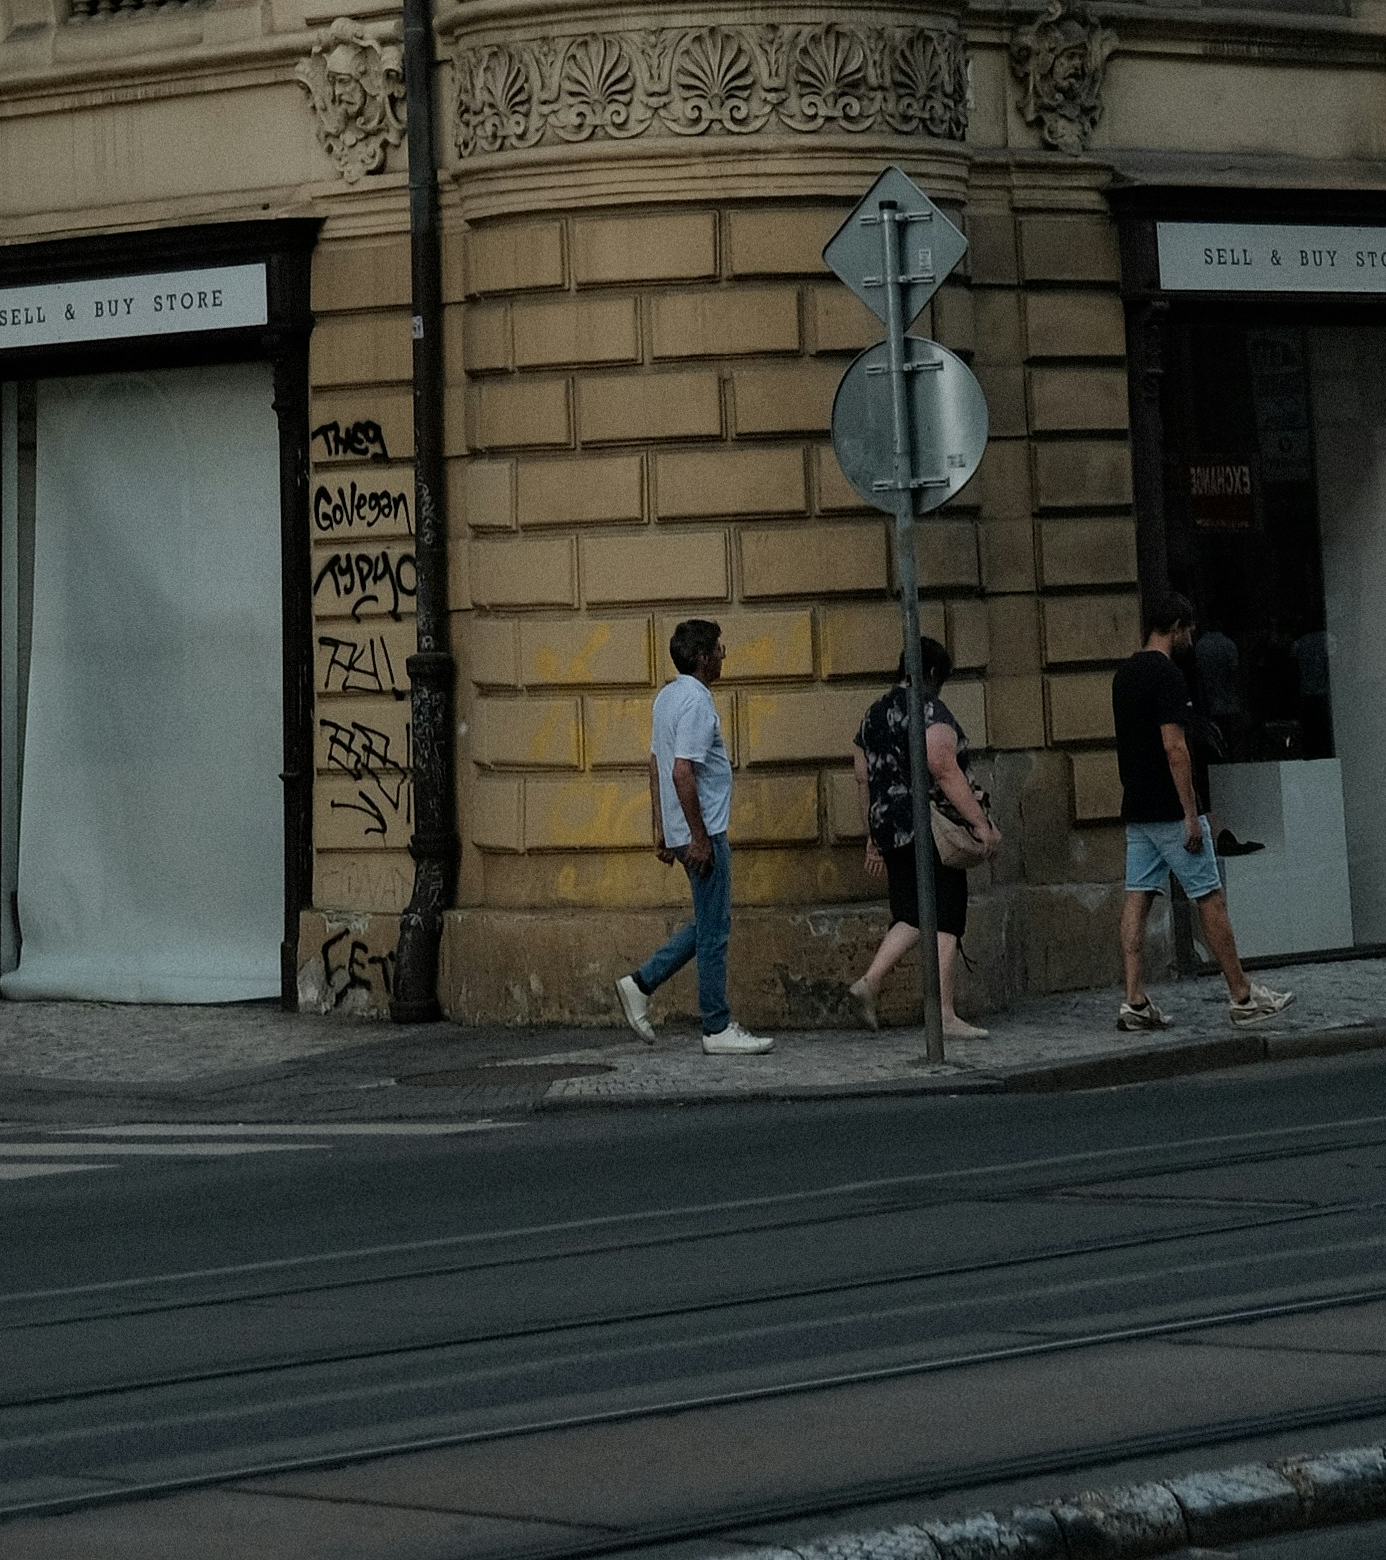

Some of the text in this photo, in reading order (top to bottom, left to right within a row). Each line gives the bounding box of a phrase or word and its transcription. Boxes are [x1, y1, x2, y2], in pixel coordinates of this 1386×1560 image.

[1204, 248, 1253, 266] SELL
[1270, 249, 1282, 266] &
[1299, 250, 1338, 268] BUY
[0, 289, 224, 327] SELL & BUY STORE
